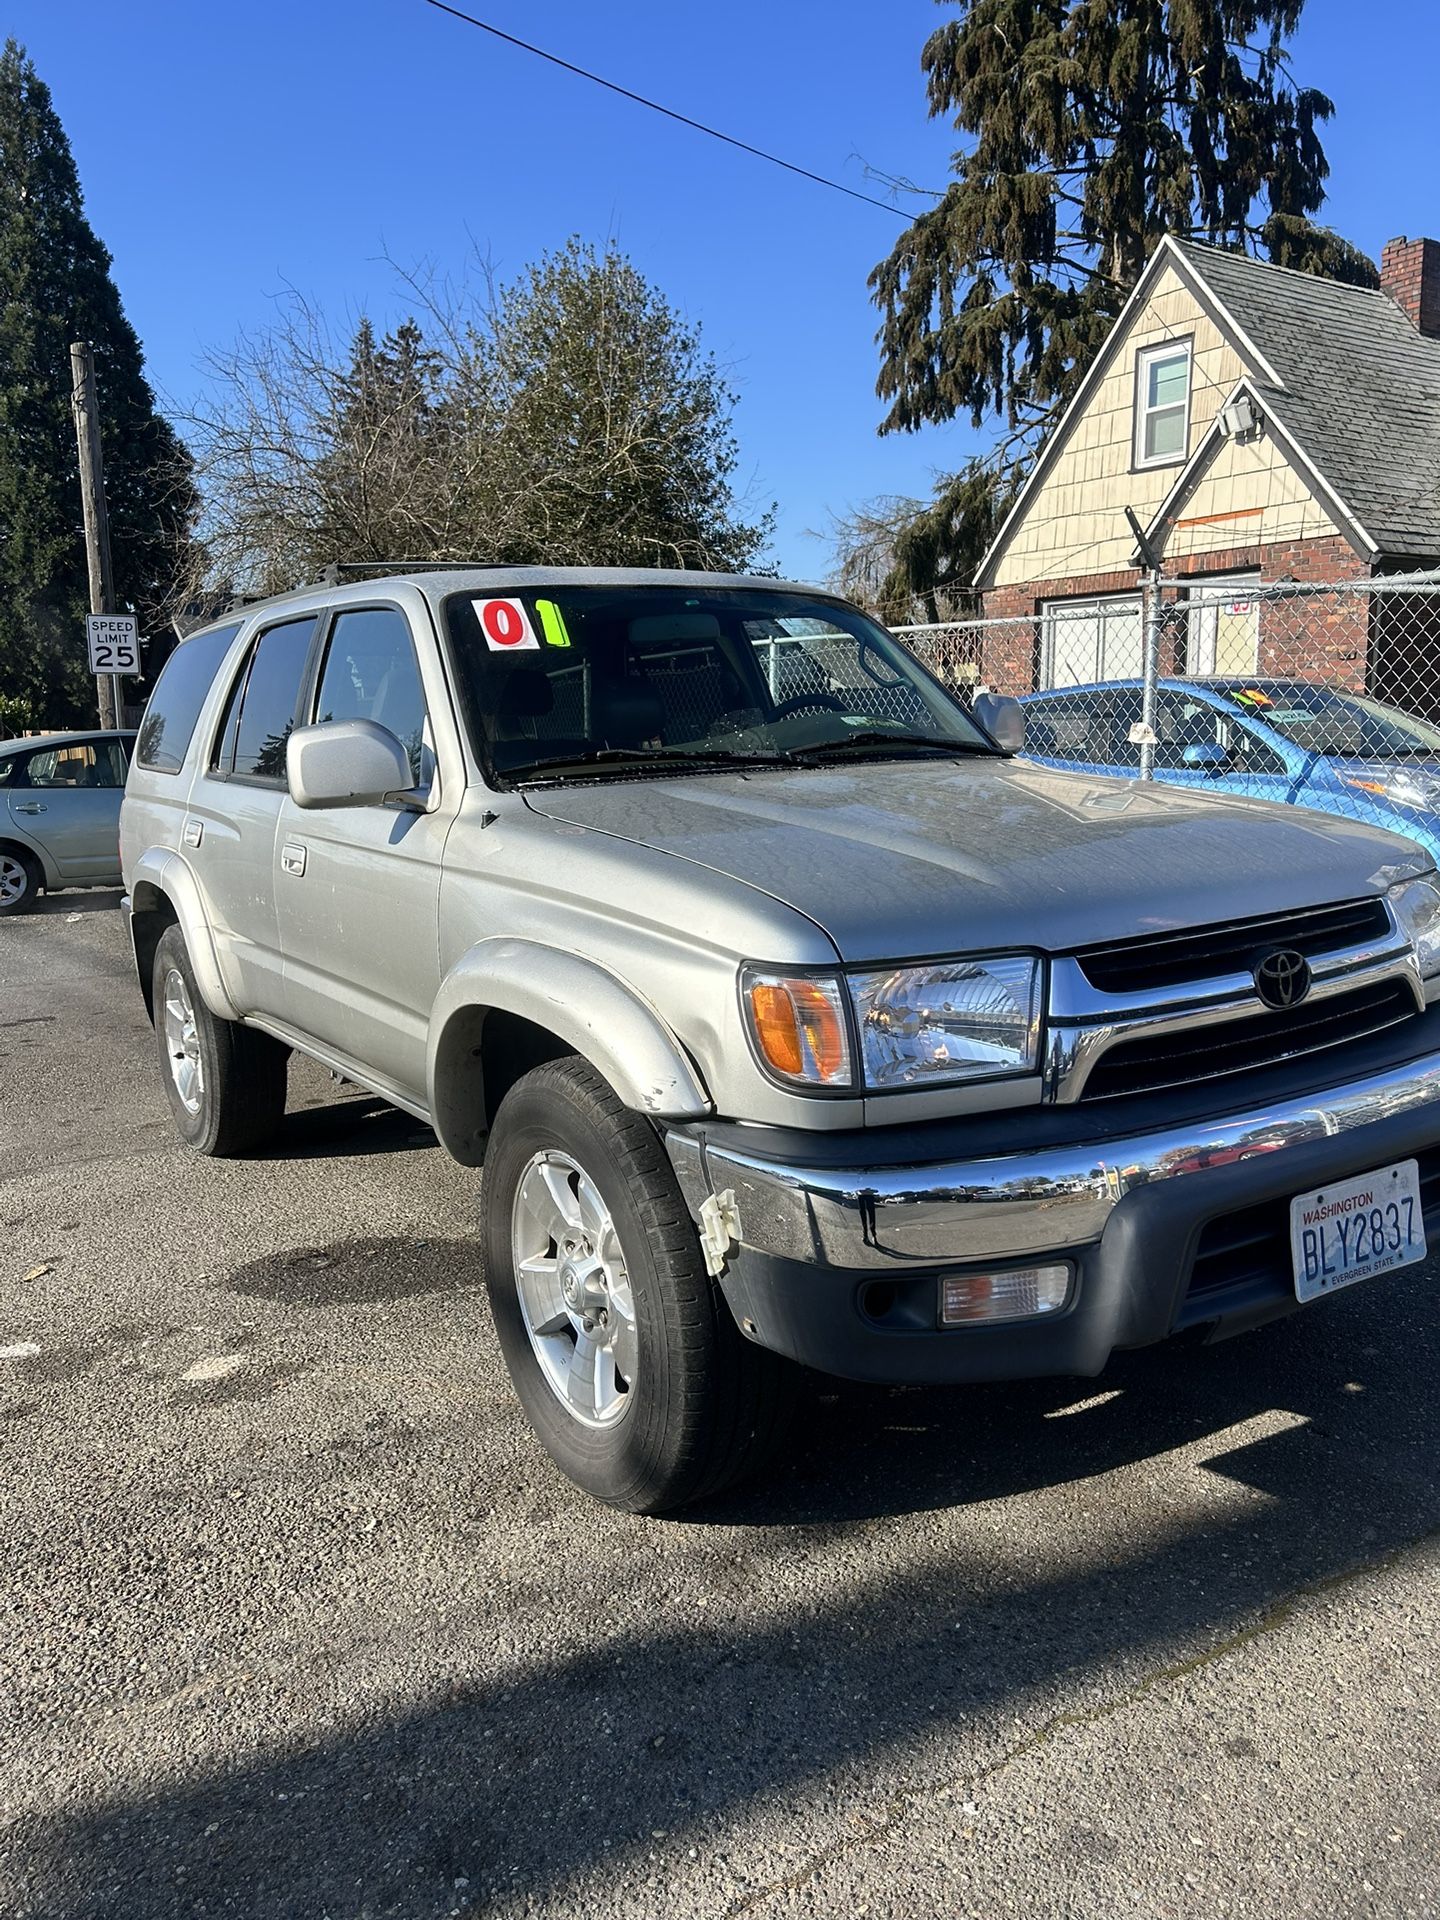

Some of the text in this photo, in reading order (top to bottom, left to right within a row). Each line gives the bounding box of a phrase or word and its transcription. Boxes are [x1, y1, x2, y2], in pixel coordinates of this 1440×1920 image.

[92, 621, 133, 631] SPEED
[97, 633, 129, 643] LIMIT
[95, 646, 134, 667] 25
[1303, 1191, 1373, 1225] WASHINGTON
[1302, 1196, 1414, 1282] BLY2837
[1373, 1256, 1395, 1271] STATE
[1331, 1265, 1371, 1286] EVERGREEN
